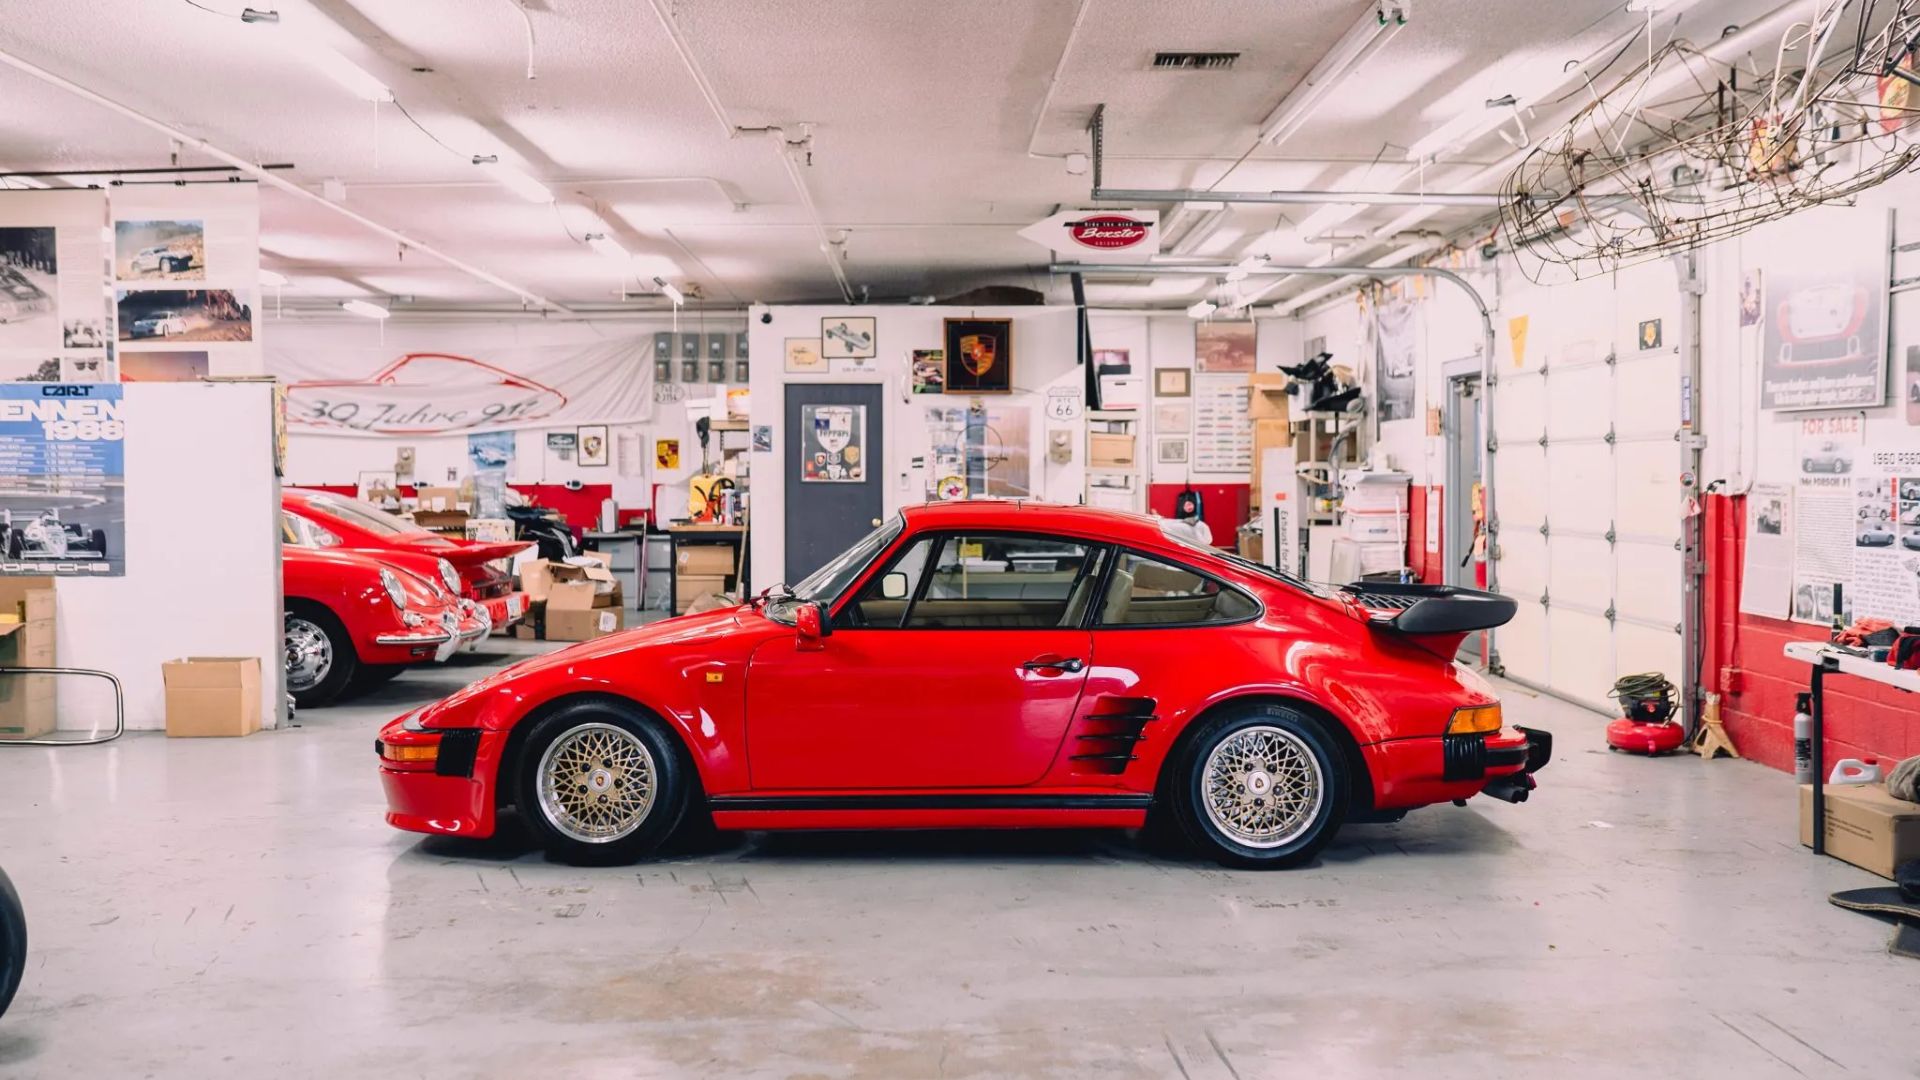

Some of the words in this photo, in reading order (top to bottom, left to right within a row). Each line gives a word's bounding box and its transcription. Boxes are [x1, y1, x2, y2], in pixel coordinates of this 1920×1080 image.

[1078, 228, 1144, 239] Boxster
[42, 385, 94, 397] CART
[301, 400, 360, 421] 30
[364, 403, 469, 431] Jahre
[1056, 404, 1072, 416] 66
[42, 420, 124, 441] 1988
[1802, 418, 1824, 435] FOR
[1829, 416, 1858, 434] SALE
[819, 430, 850, 439] Ferrari
[1873, 452, 1895, 465] 1960
[0, 562, 111, 572] ORSCHE
